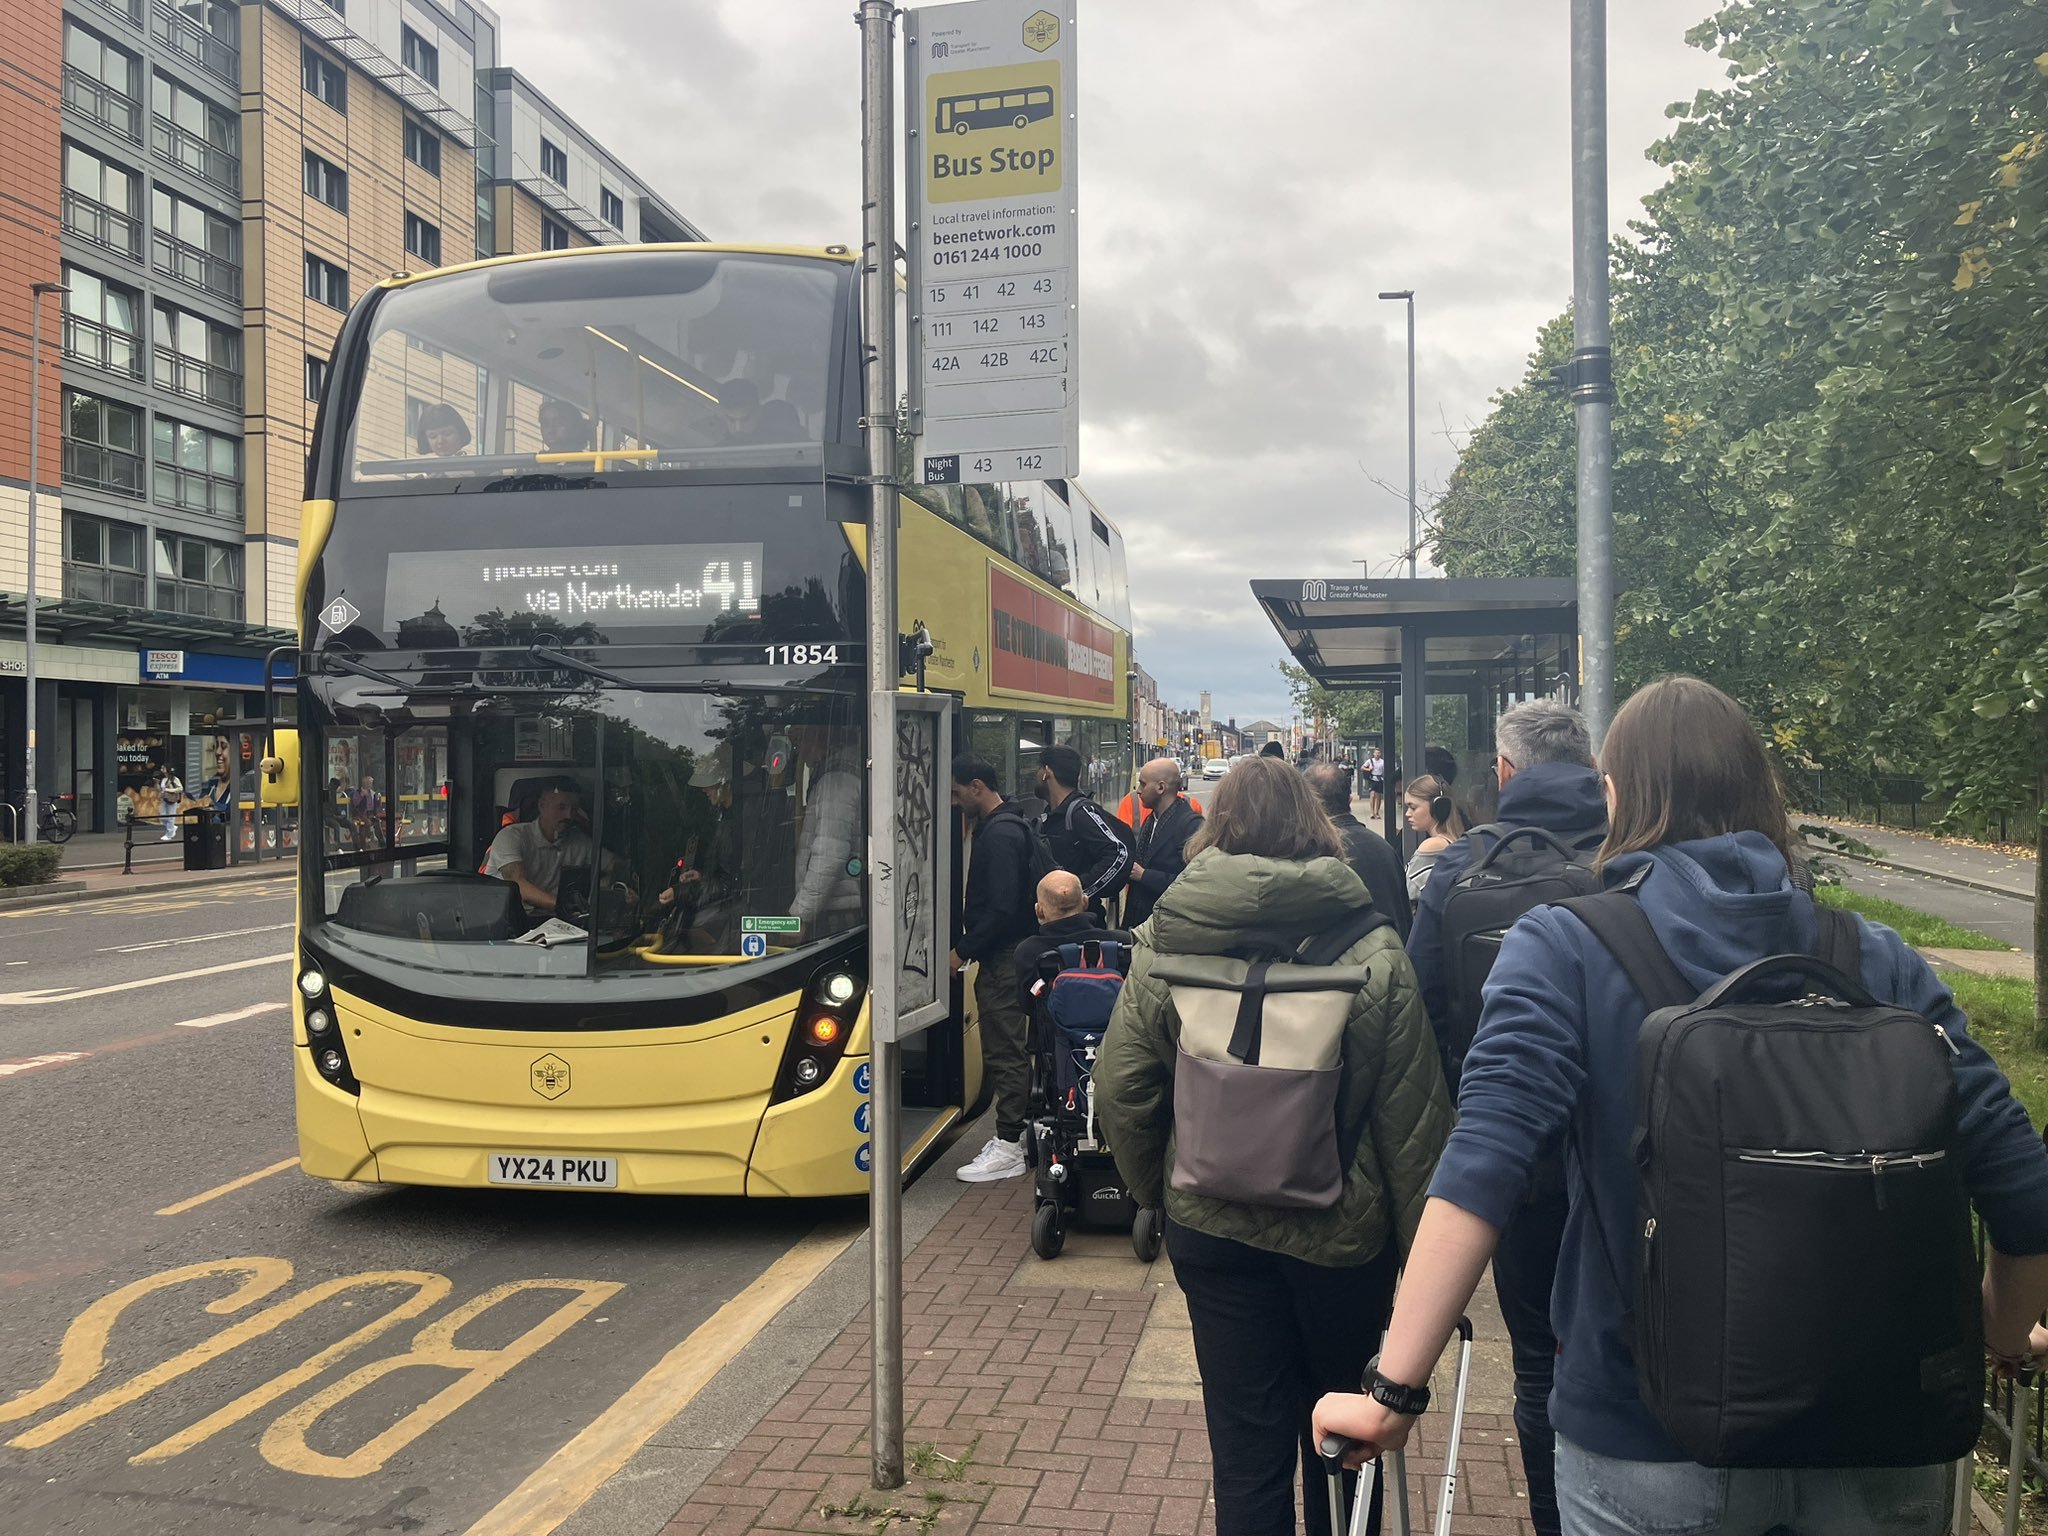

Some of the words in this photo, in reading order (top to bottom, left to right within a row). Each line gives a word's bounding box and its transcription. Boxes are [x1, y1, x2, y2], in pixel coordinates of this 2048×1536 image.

[933, 154, 983, 179] Bus
[990, 147, 1055, 175] Stop
[933, 213, 959, 225] Local
[961, 210, 990, 222] travel
[992, 204, 1056, 220] information:
[933, 223, 1056, 245] beenetwork.com
[933, 251, 967, 265] 0161
[971, 247, 1000, 262] 244
[1003, 243, 1042, 259] 1000
[930, 288, 946, 303] 15
[962, 285, 979, 300] 41
[997, 282, 1016, 297] 42
[1033, 279, 1052, 293] 43
[931, 322, 952, 337] 111
[973, 318, 999, 333] 142
[1019, 314, 1046, 330] 143
[932, 356, 960, 371] 42A
[980, 352, 1009, 368] 42B
[1030, 347, 1058, 363] 42C
[928, 458, 953, 470] Night
[974, 458, 992, 472] 43
[1016, 455, 1042, 470] 142
[928, 471, 945, 481] Bus
[703, 561, 758, 611] 41
[1329, 584, 1358, 592] Transprt
[1329, 591, 1352, 599] Greater
[1353, 591, 1388, 599] Manchester
[526, 588, 561, 611] via
[2, 660, 27, 671] SHOP
[150, 652, 178, 660] TESCO
[764, 644, 839, 666] 11854
[149, 662, 177, 671] express
[137, 743, 148, 752] for
[129, 753, 149, 765] today
[498, 1156, 555, 1181] YX24
[562, 1159, 607, 1183] PKU
[0, 1256, 628, 1480] BUS
